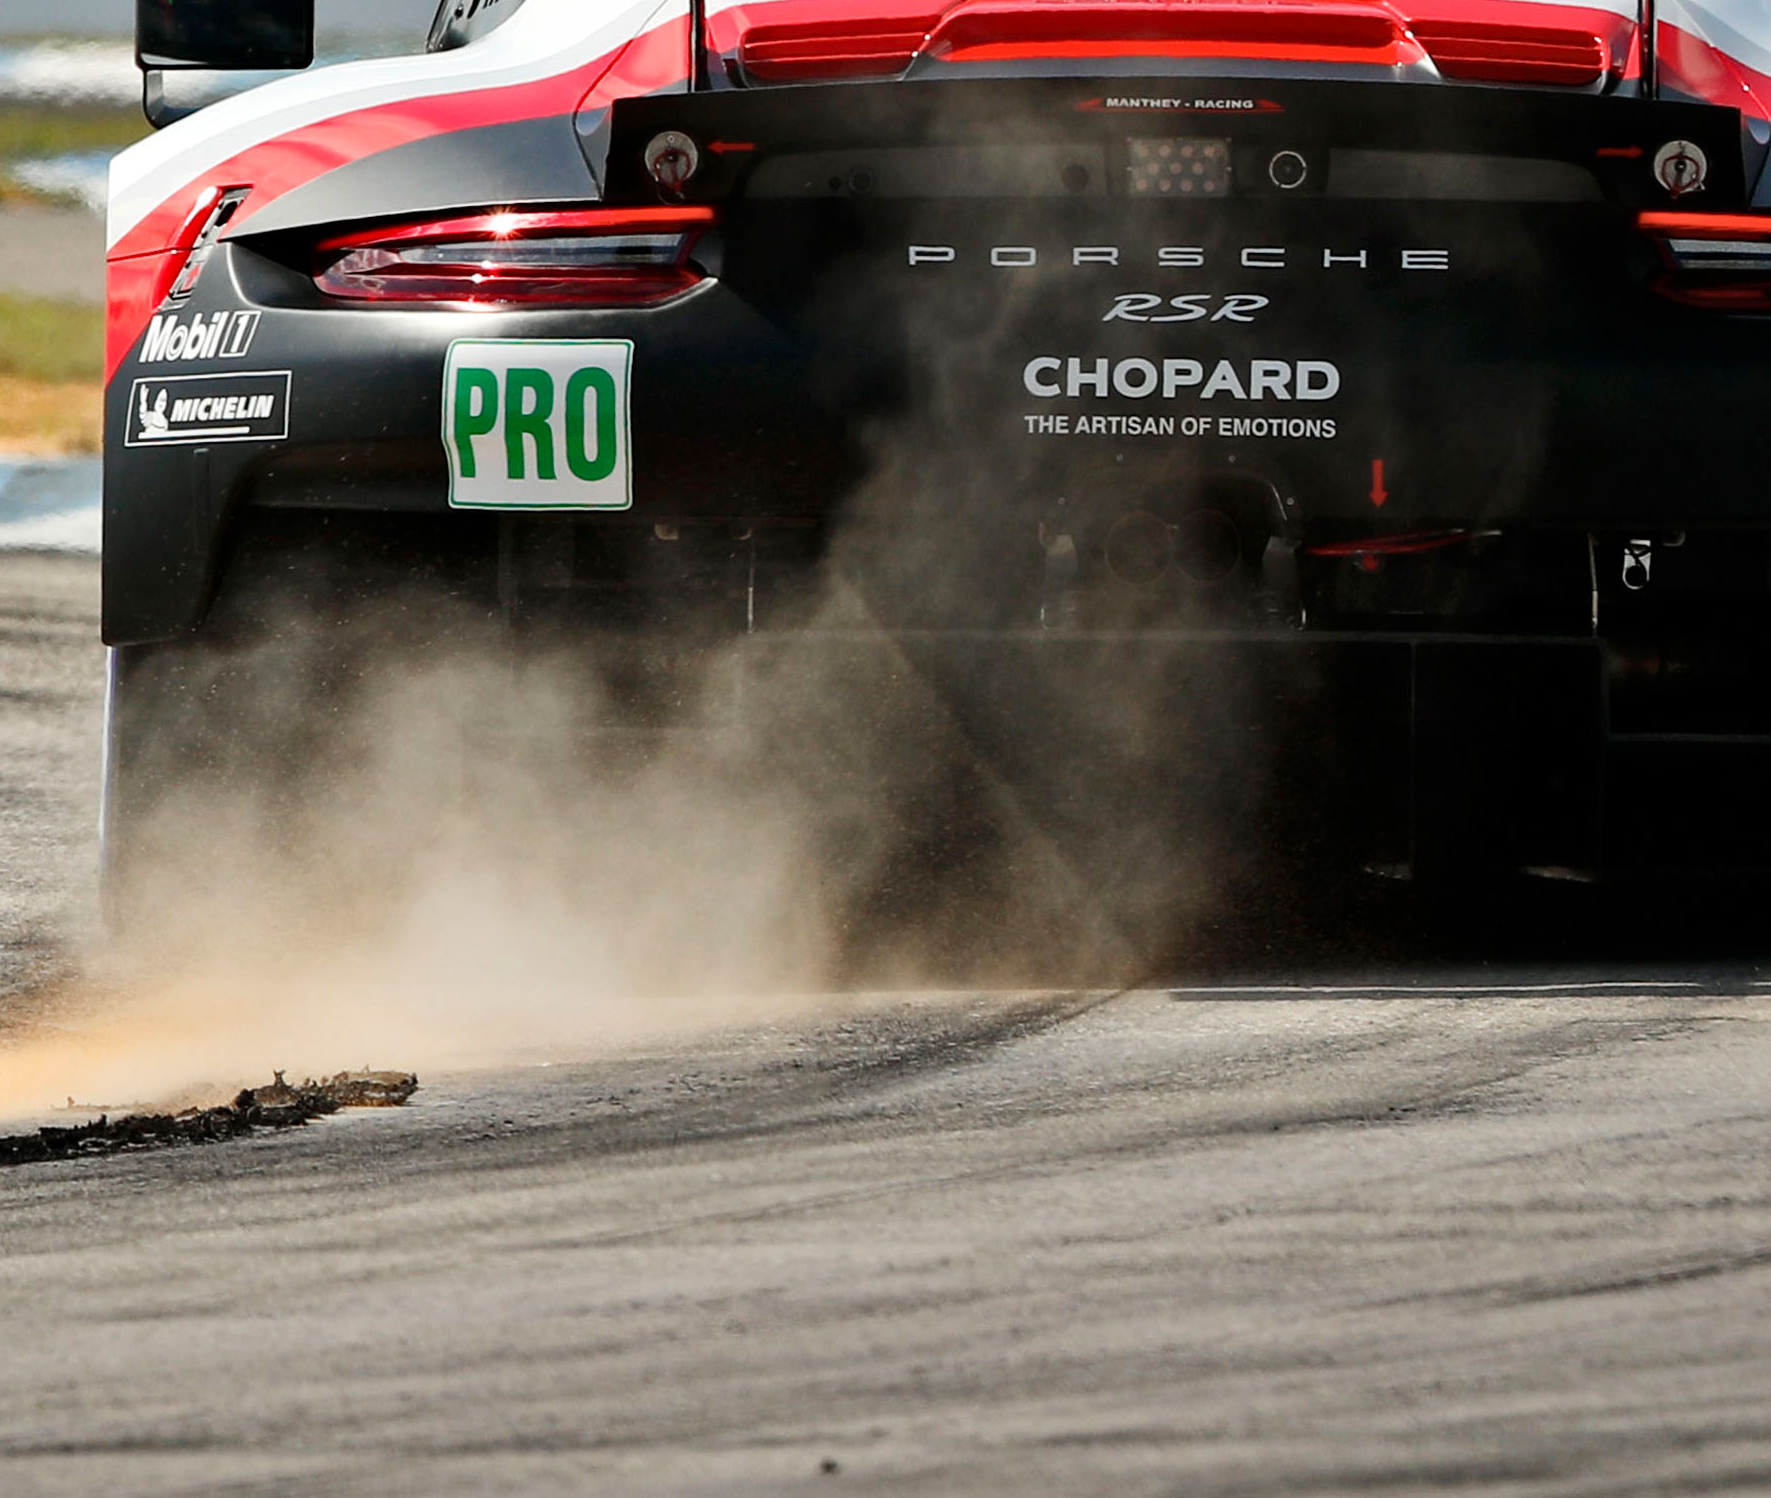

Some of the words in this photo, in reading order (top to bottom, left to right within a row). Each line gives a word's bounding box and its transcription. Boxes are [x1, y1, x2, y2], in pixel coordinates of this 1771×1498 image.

[1106, 97, 1181, 108] MANTHEY
[1194, 99, 1254, 109] RACING
[908, 245, 1449, 269] PORSCHE
[1101, 293, 1270, 322] RSR
[139, 312, 229, 363] Mobil
[1023, 356, 1341, 401] CHOPARD
[170, 394, 274, 422] MICHELIN
[454, 366, 617, 482] PRO
[1024, 415, 1069, 434] THE
[1075, 416, 1175, 436] ARTISAN
[1180, 417, 1212, 436] OF
[1218, 418, 1337, 438] EMOTIONS
